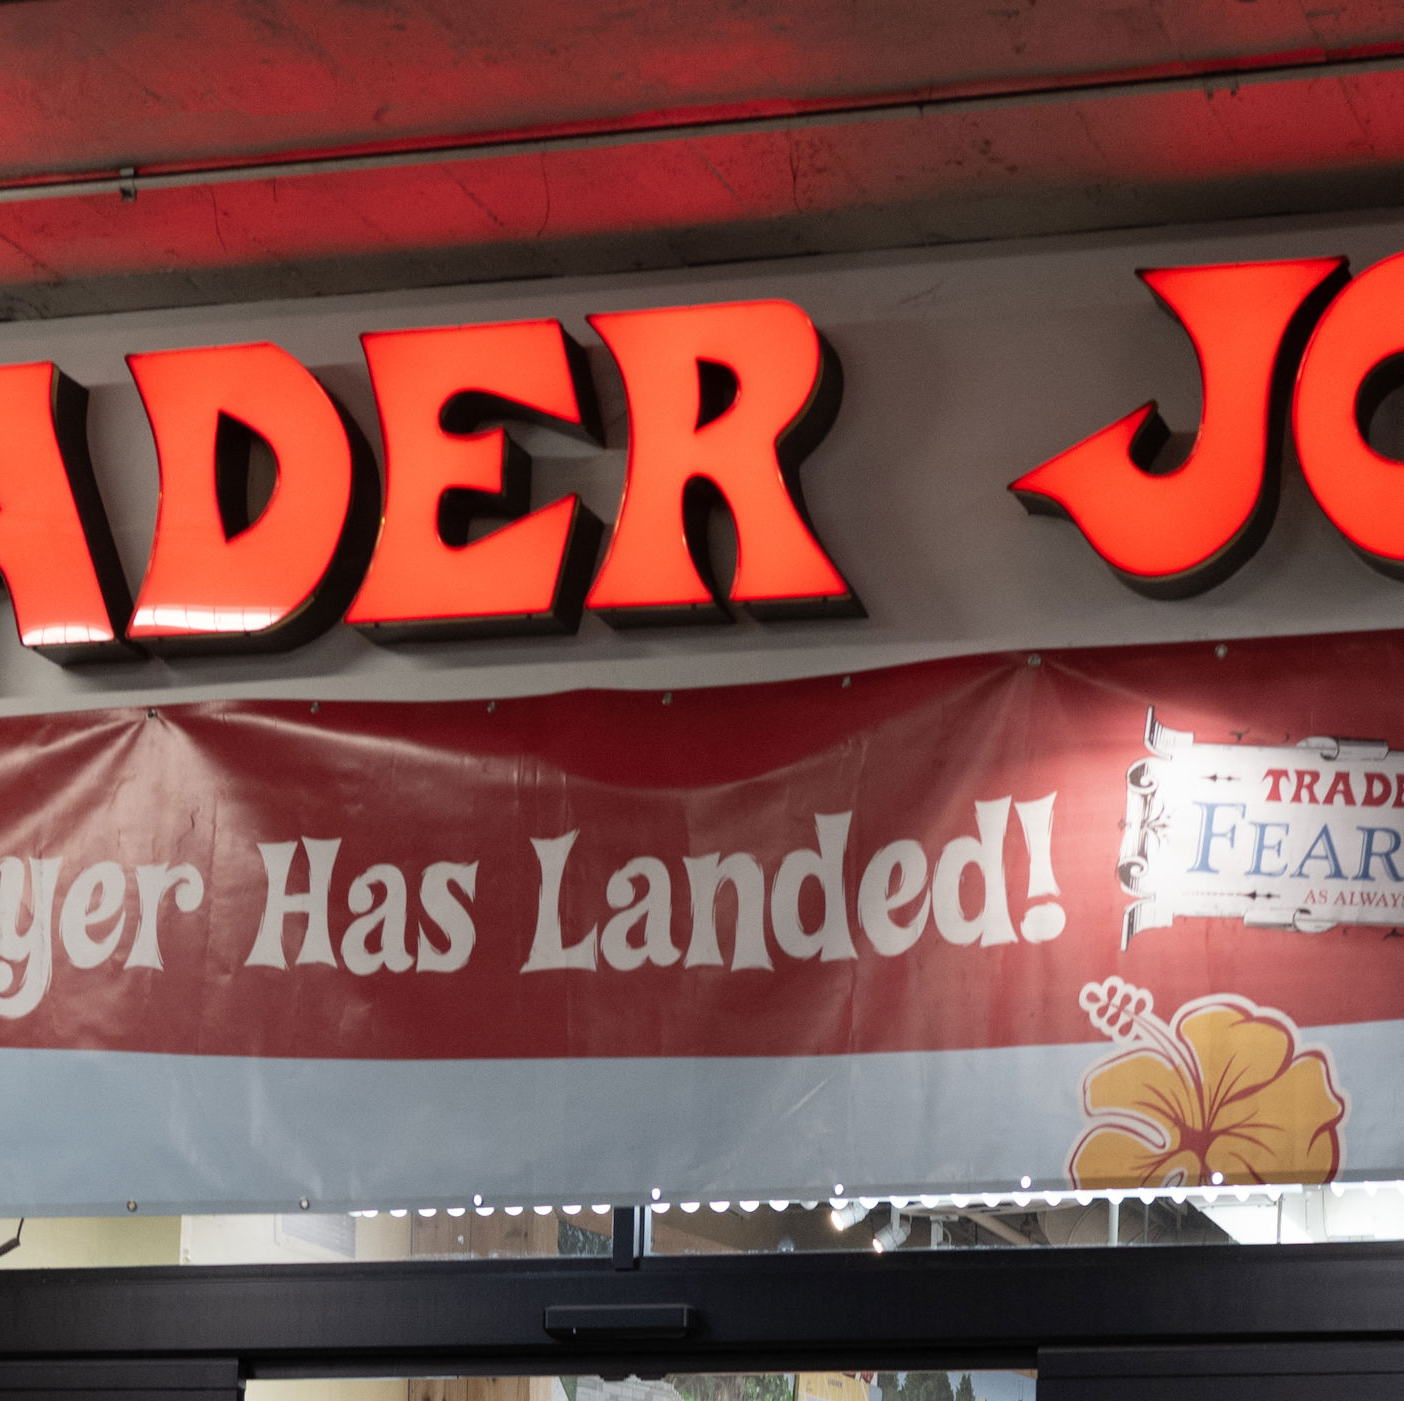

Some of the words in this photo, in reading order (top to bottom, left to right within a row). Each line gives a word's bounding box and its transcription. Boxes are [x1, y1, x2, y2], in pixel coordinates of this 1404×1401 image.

[244, 836, 479, 976] Has
[520, 791, 1068, 973] Landed!
[1303, 890, 1328, 905] AS
